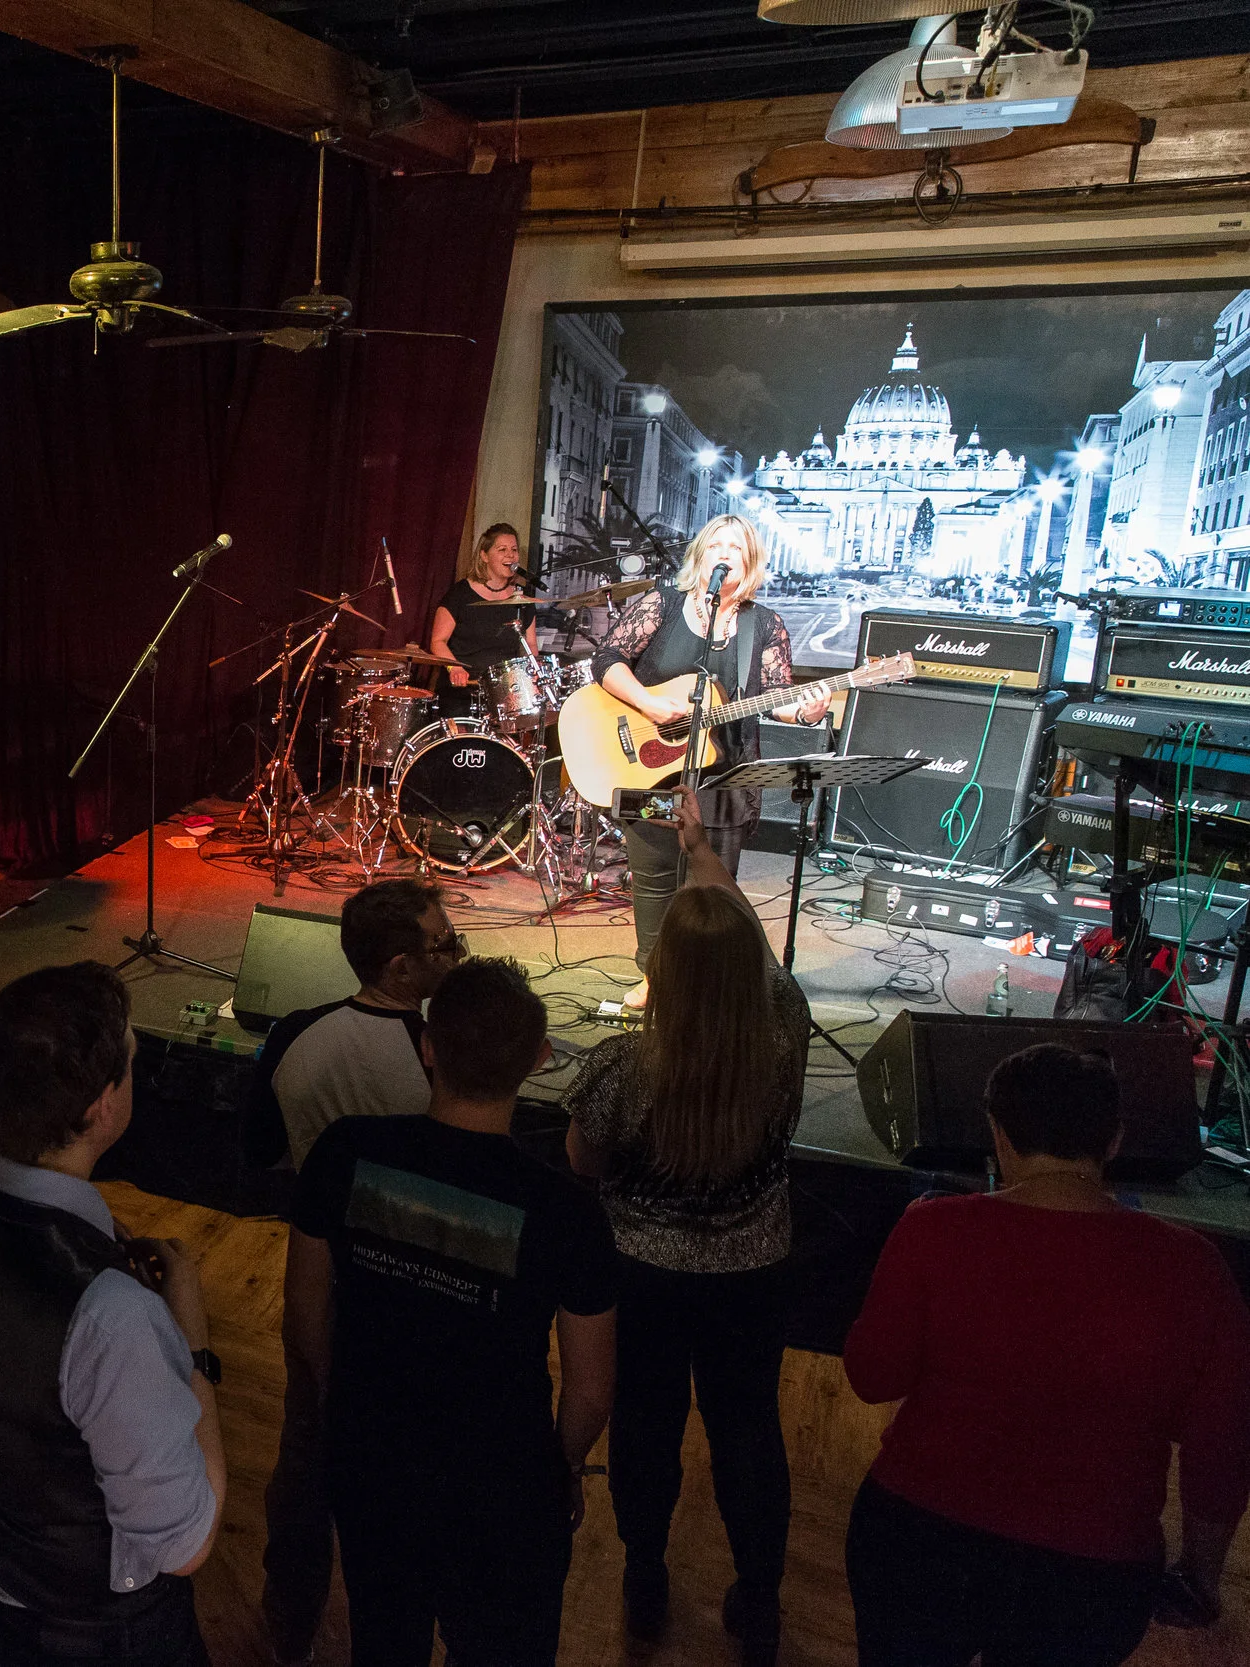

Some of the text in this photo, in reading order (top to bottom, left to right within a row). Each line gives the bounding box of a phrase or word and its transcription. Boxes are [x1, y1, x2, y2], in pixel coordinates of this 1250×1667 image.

[915, 633, 991, 657] Marshall
[1086, 711, 1137, 728] YAMAHA
[452, 749, 486, 768] dw
[904, 749, 969, 774] shall
[1071, 813, 1112, 831] YAMAHA
[424, 1265, 481, 1295] CONCEPT
